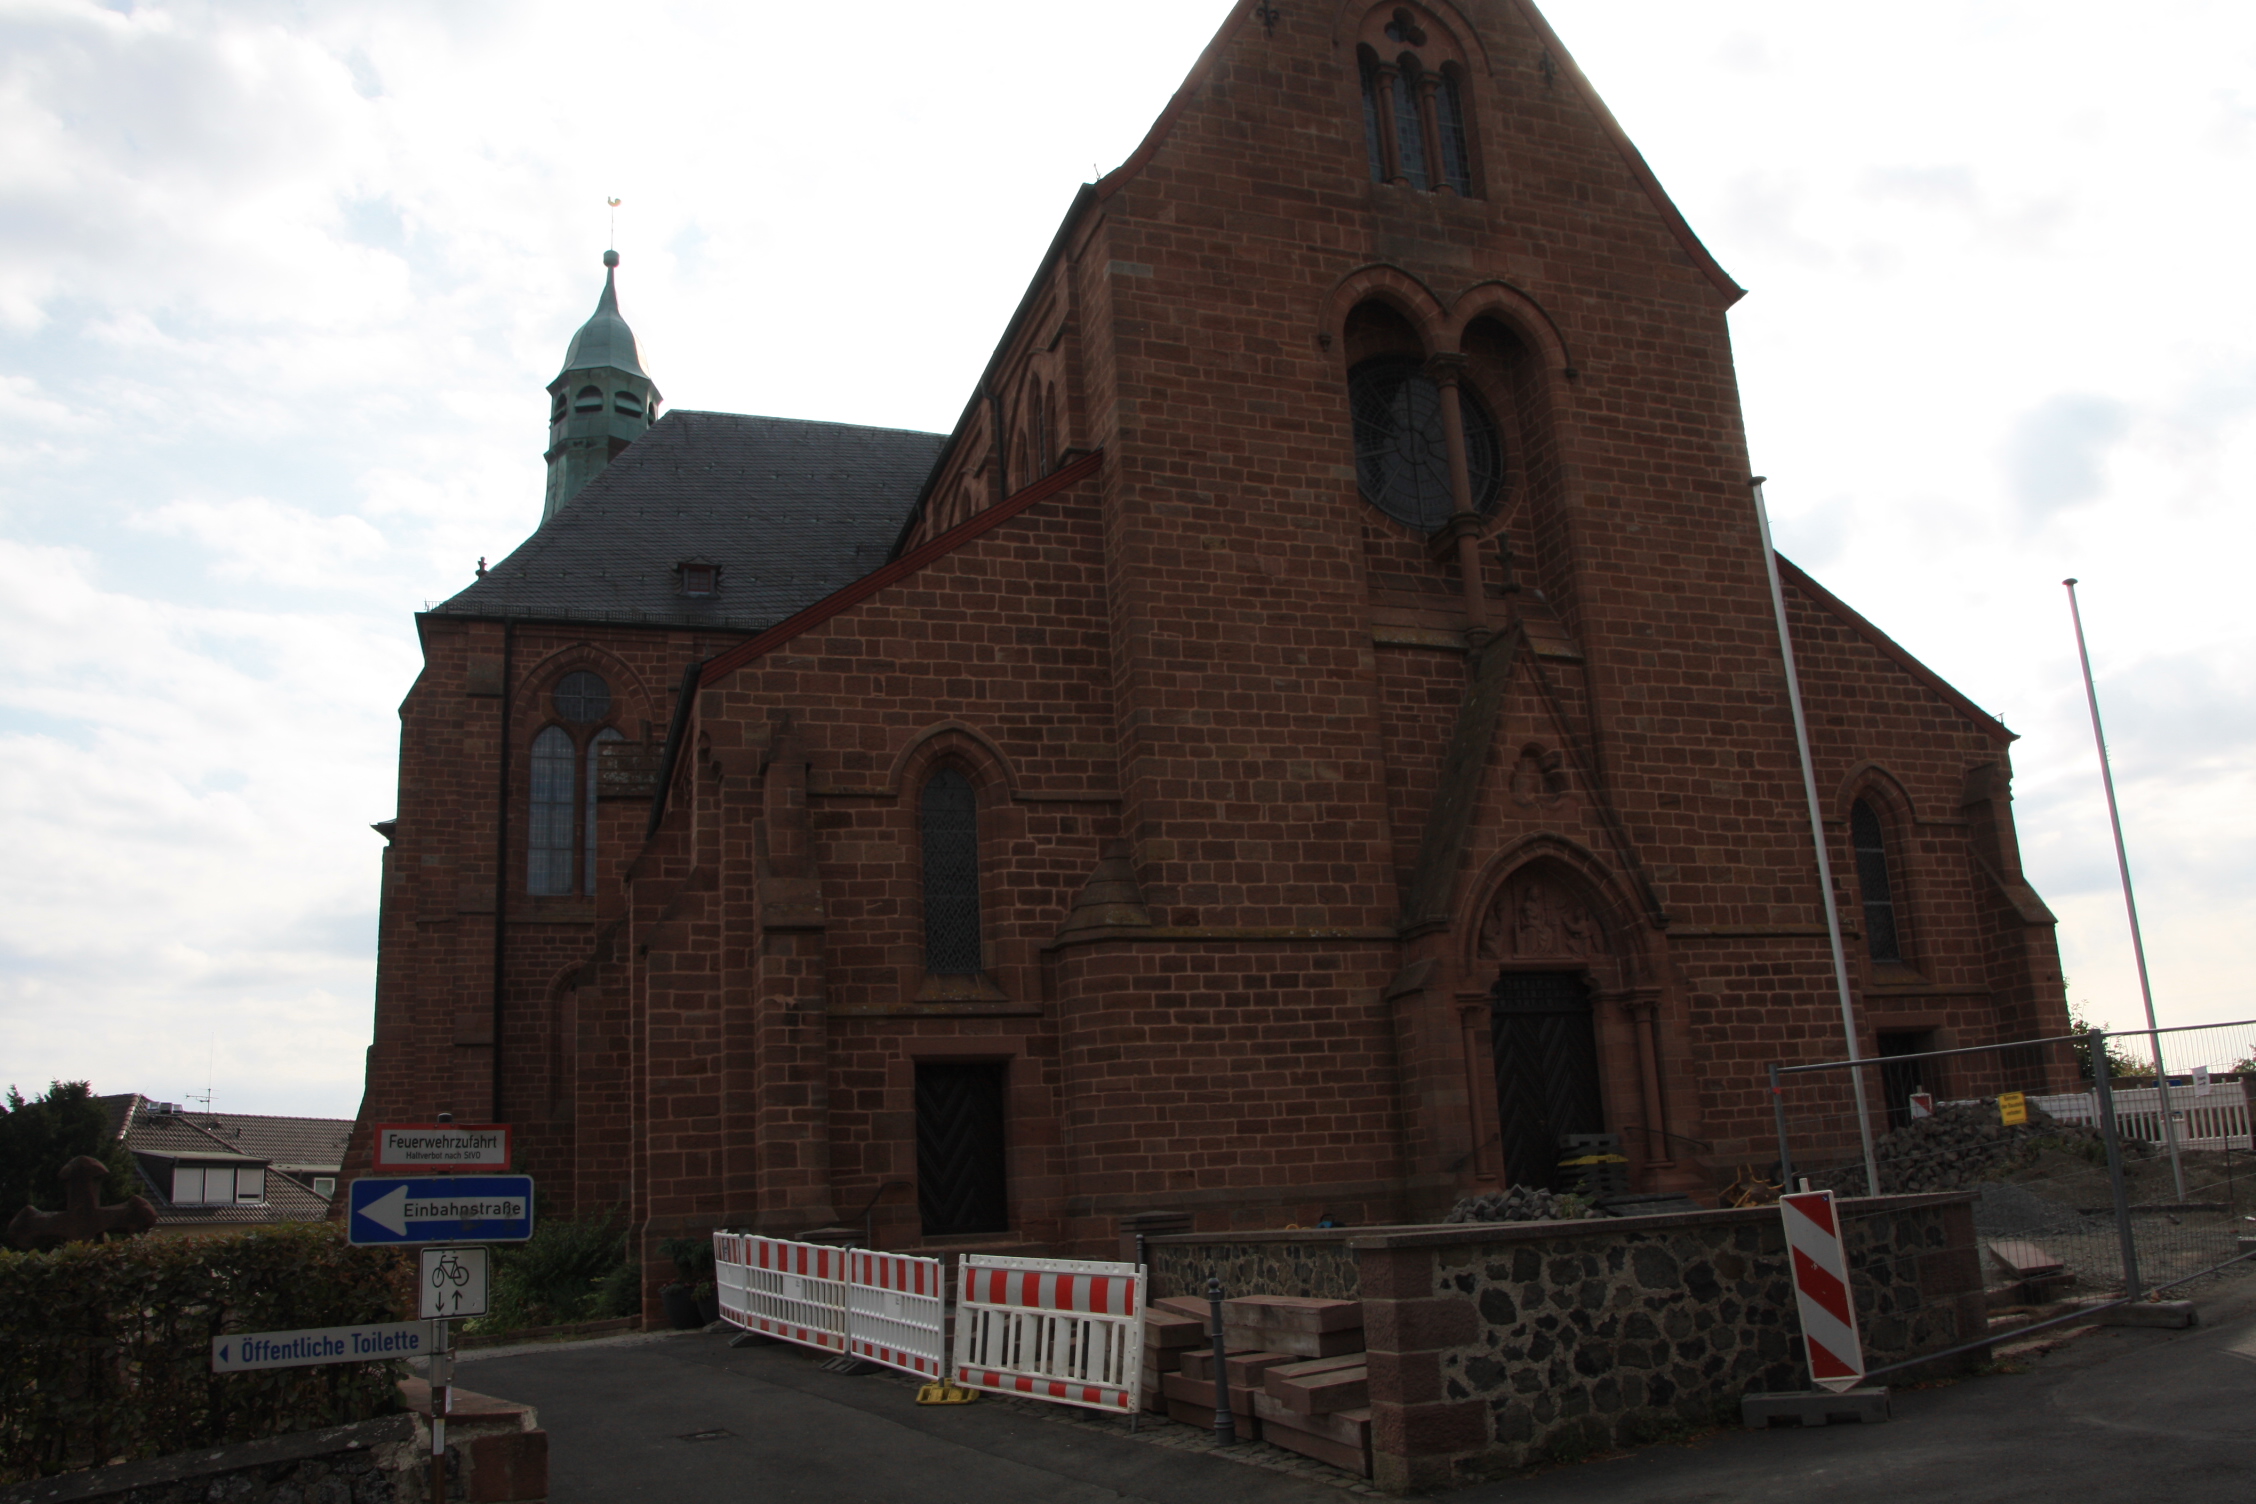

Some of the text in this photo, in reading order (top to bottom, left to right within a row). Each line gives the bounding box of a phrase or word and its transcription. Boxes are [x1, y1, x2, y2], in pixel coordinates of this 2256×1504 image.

[389, 1134, 497, 1149] Feuerwehrzufahrt
[405, 1151, 481, 1160] Haltverbot nach StVO
[404, 1201, 521, 1218] Einbahnstraße
[241, 1330, 419, 1363] Öffentliche Toilette
